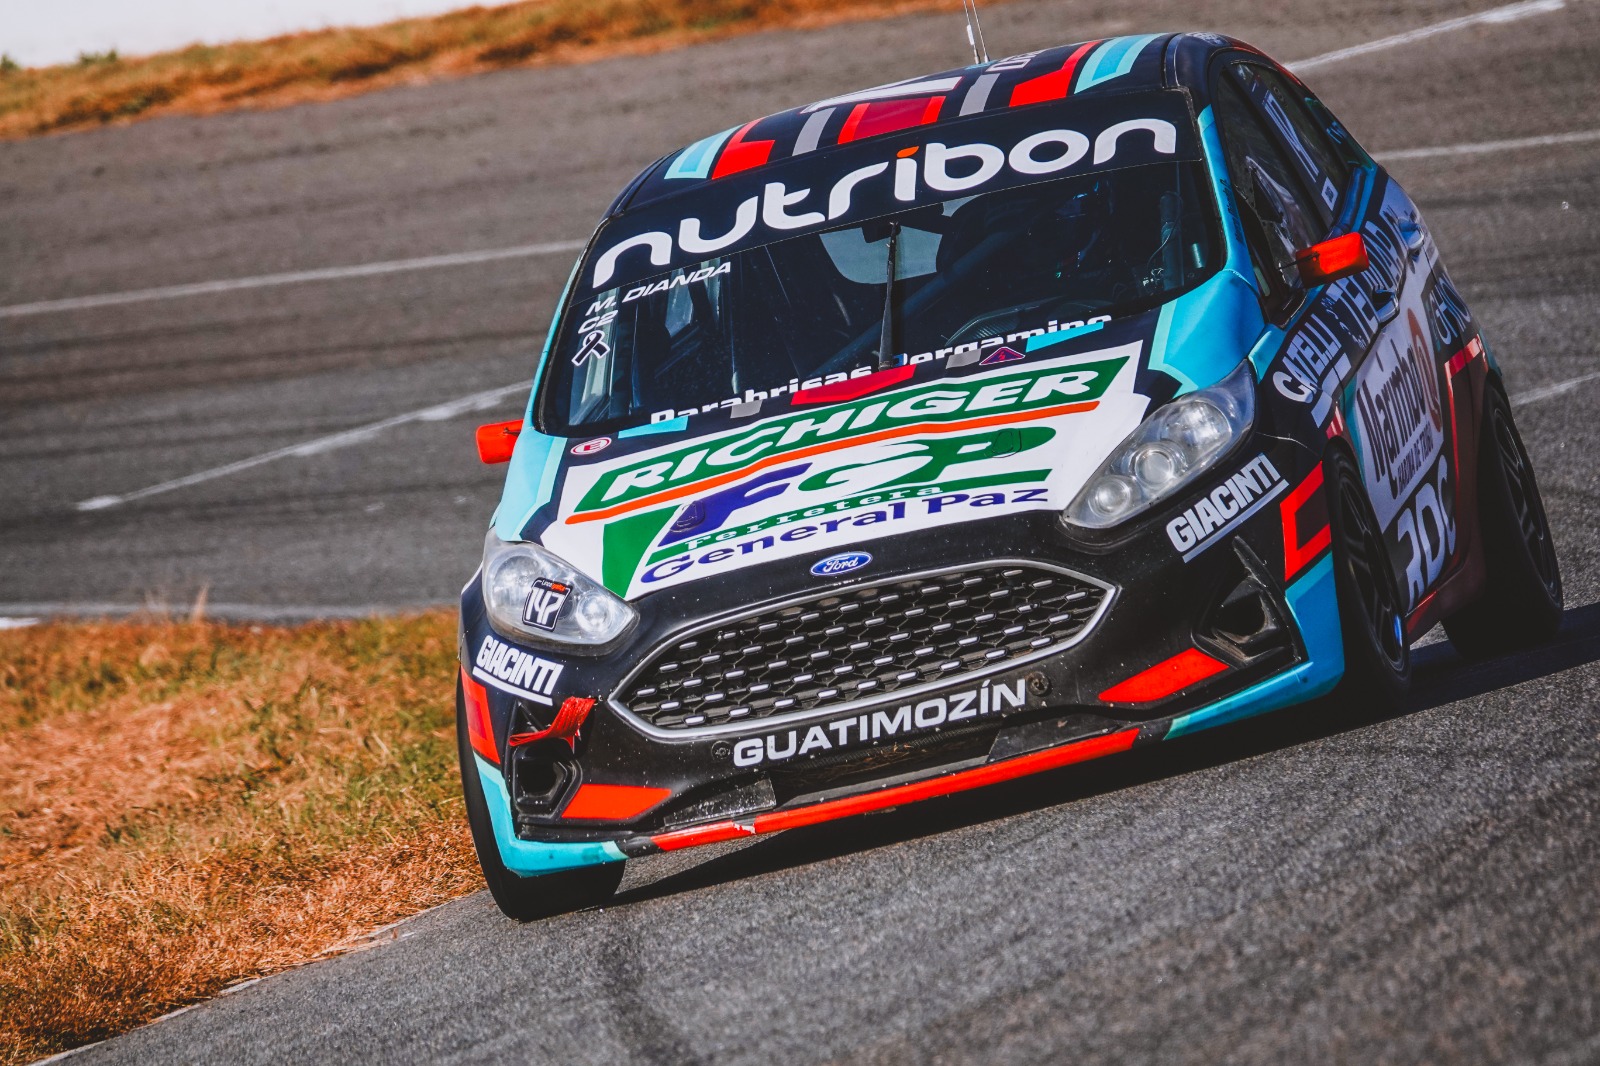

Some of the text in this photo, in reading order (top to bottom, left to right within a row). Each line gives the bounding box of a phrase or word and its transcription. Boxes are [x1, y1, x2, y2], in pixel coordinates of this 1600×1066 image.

[593, 119, 1177, 288] nutribon
[578, 309, 618, 334] C2
[585, 262, 731, 316] M. DIANDA
[1272, 313, 1342, 404] GATELLI
[602, 370, 1099, 503] RICHIGER
[640, 488, 1049, 584] General Paz
[685, 486, 943, 551] Ferretera
[1166, 452, 1281, 553] GIACINTI
[822, 556, 859, 573] Ford
[525, 586, 566, 625] 147
[475, 634, 564, 696] GIACINTI
[733, 680, 1027, 768] GUATIMOZÍN
